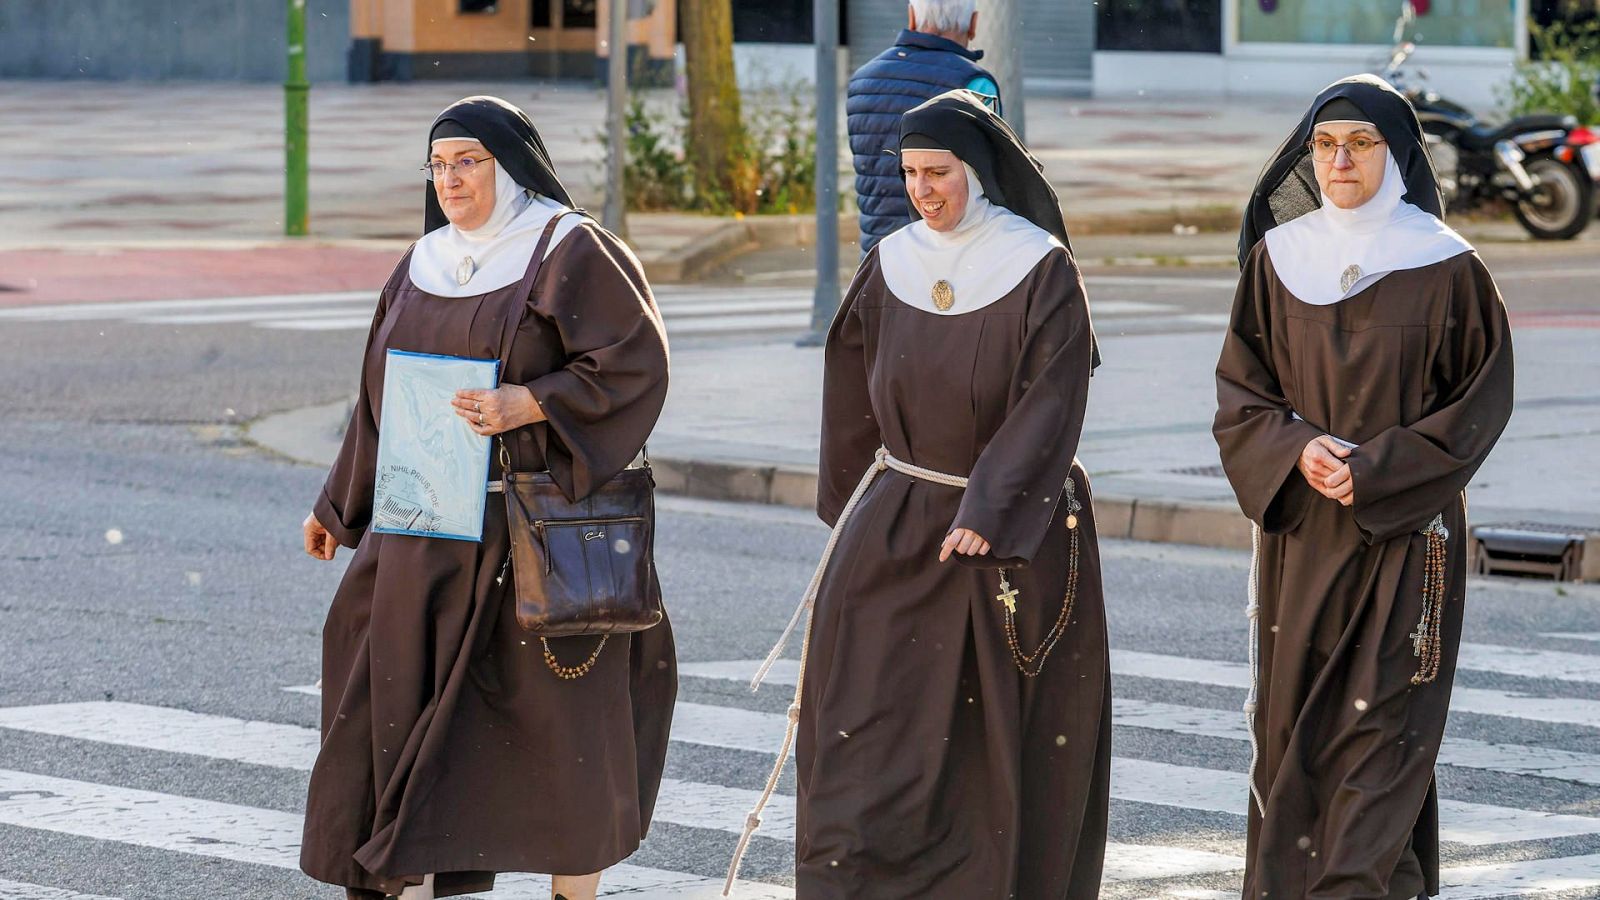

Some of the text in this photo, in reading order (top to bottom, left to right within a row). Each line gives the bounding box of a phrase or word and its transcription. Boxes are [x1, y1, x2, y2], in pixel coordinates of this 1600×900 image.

[390, 464, 440, 508] NIHIL PRIUS FIDE
